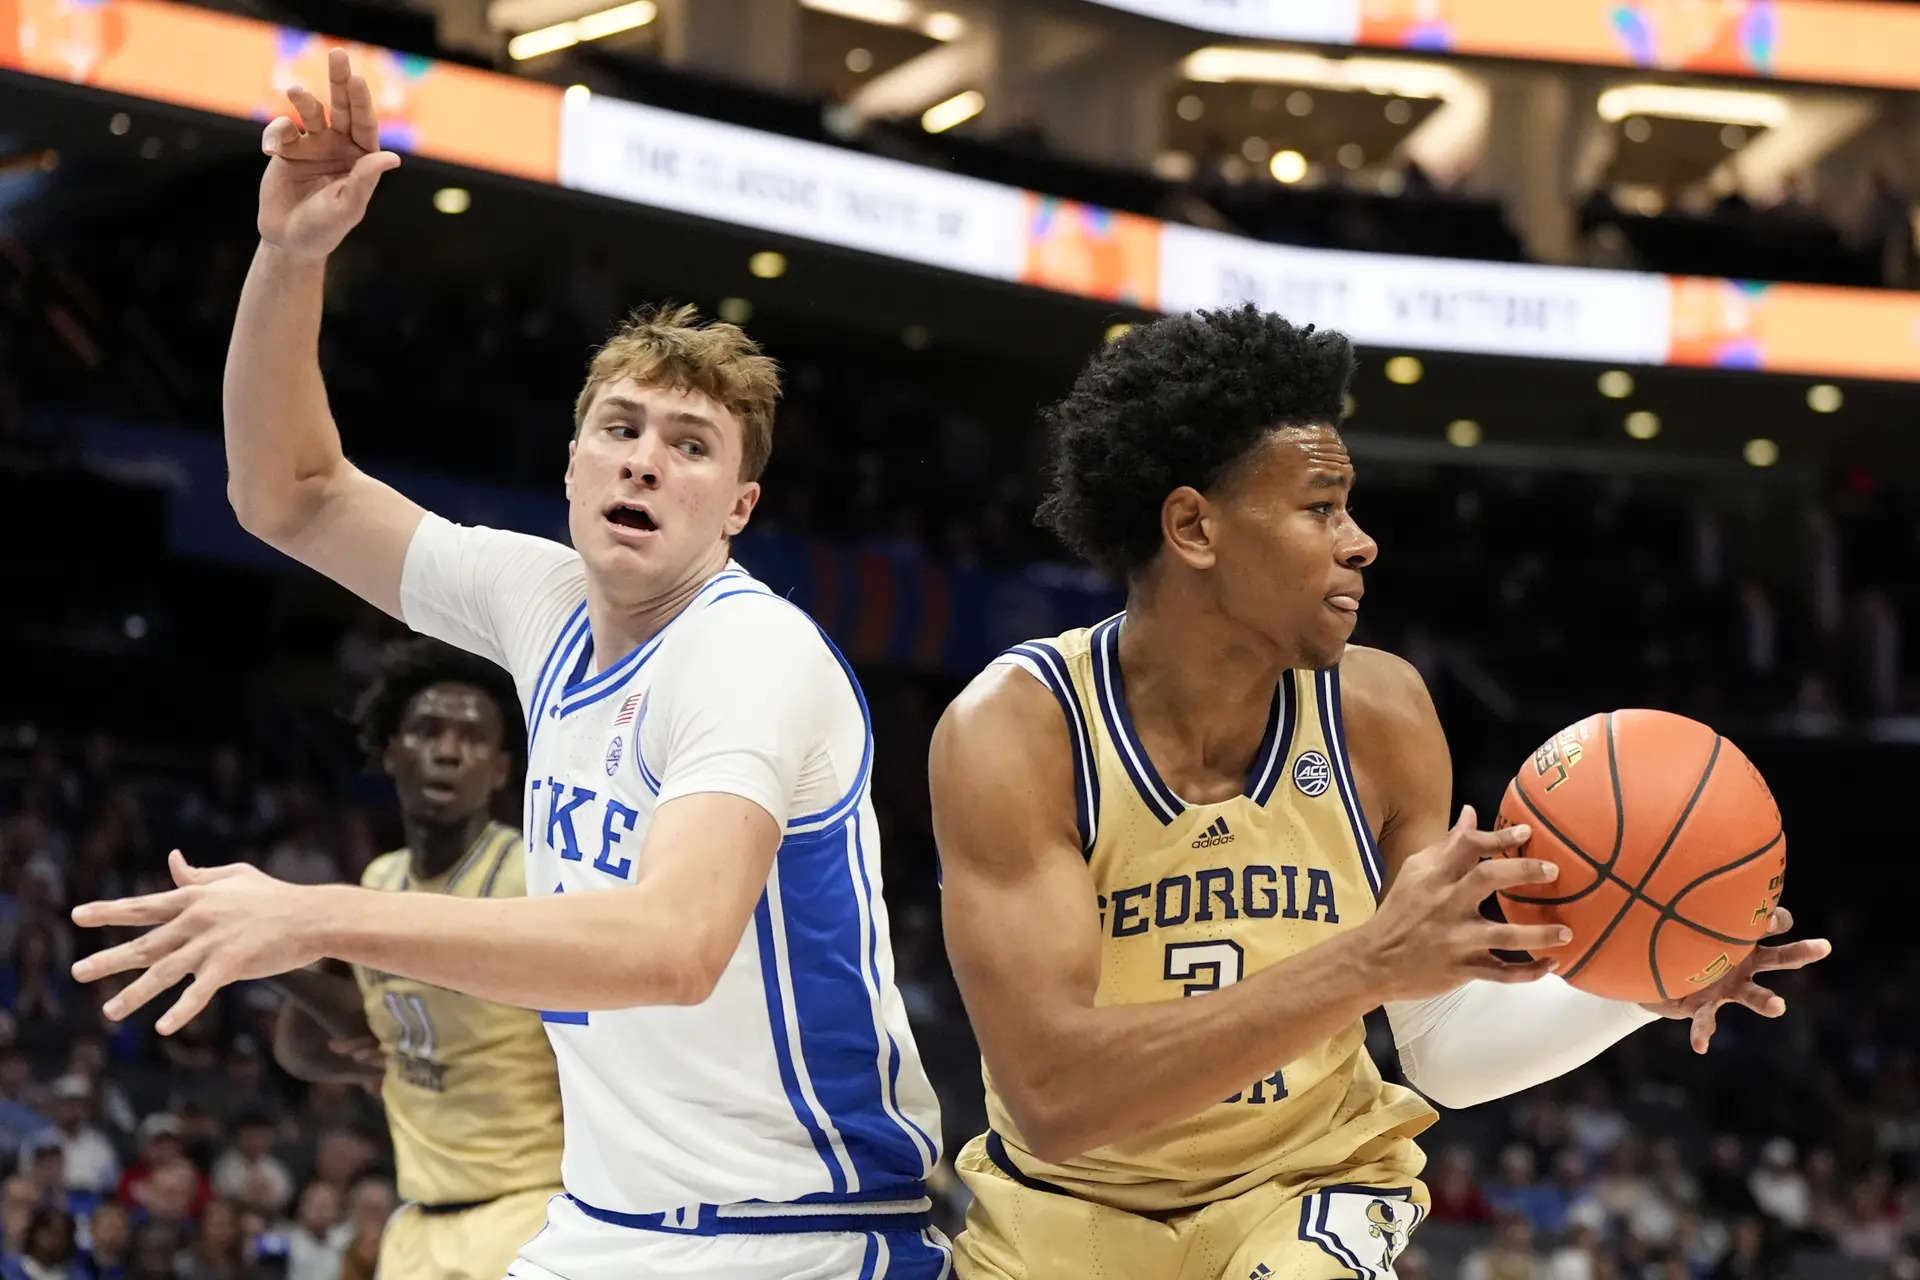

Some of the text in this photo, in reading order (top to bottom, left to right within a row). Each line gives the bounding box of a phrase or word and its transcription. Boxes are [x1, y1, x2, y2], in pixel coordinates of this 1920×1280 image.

[1299, 765, 1328, 777] ACC
[529, 776, 639, 879] KE
[1191, 833, 1235, 849] adidas
